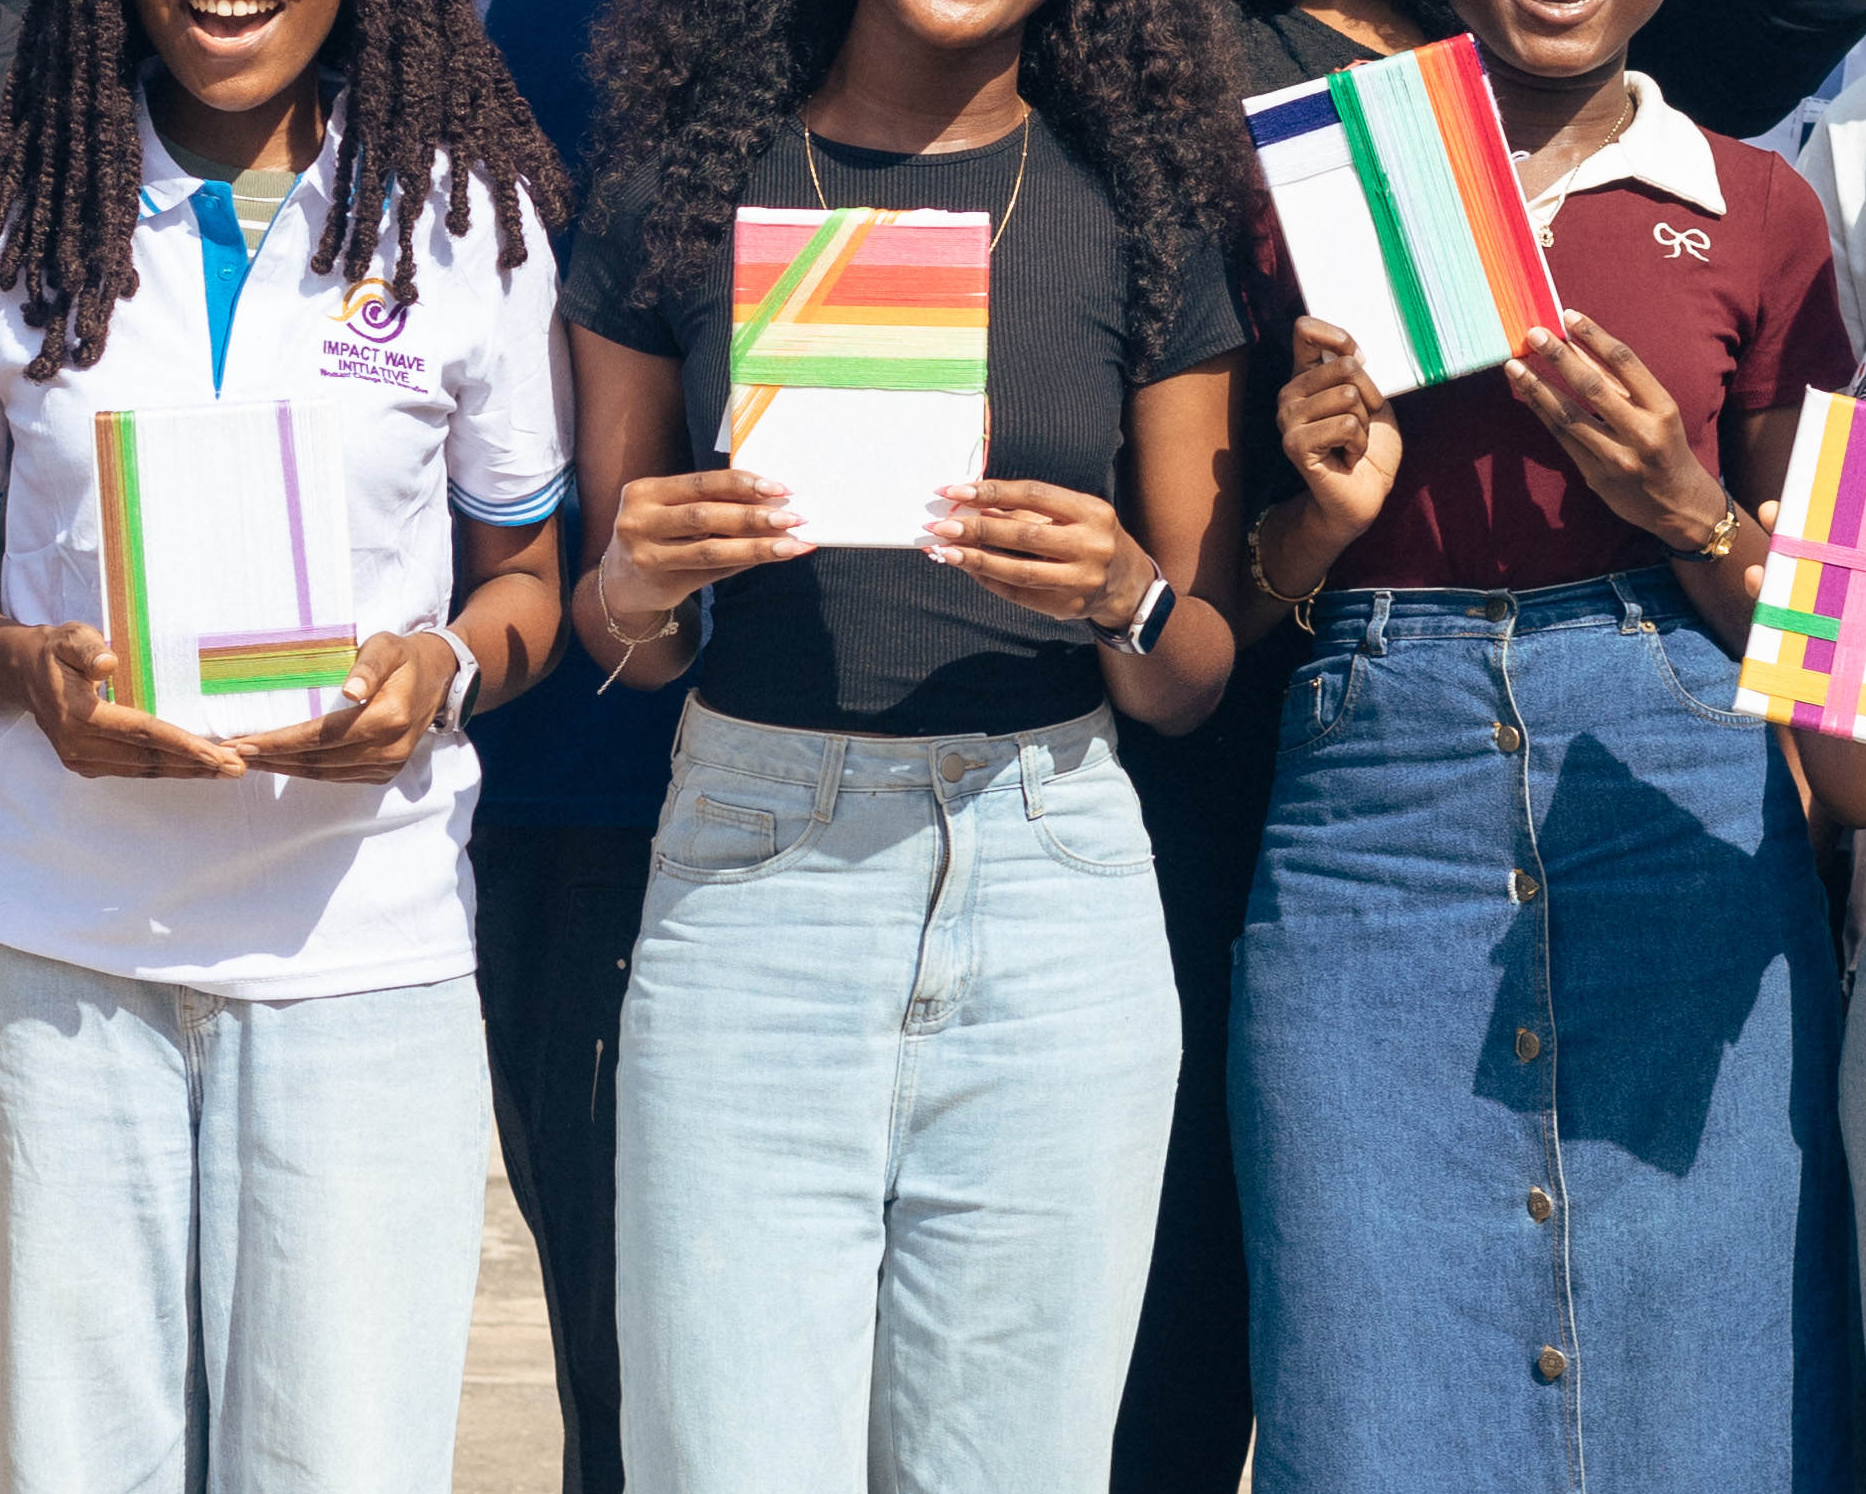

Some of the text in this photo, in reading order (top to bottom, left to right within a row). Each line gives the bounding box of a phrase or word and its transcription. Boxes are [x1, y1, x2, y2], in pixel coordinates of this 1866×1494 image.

[323, 340, 425, 372] IMPACT WAVE
[339, 359, 410, 383] INITIATIVE
